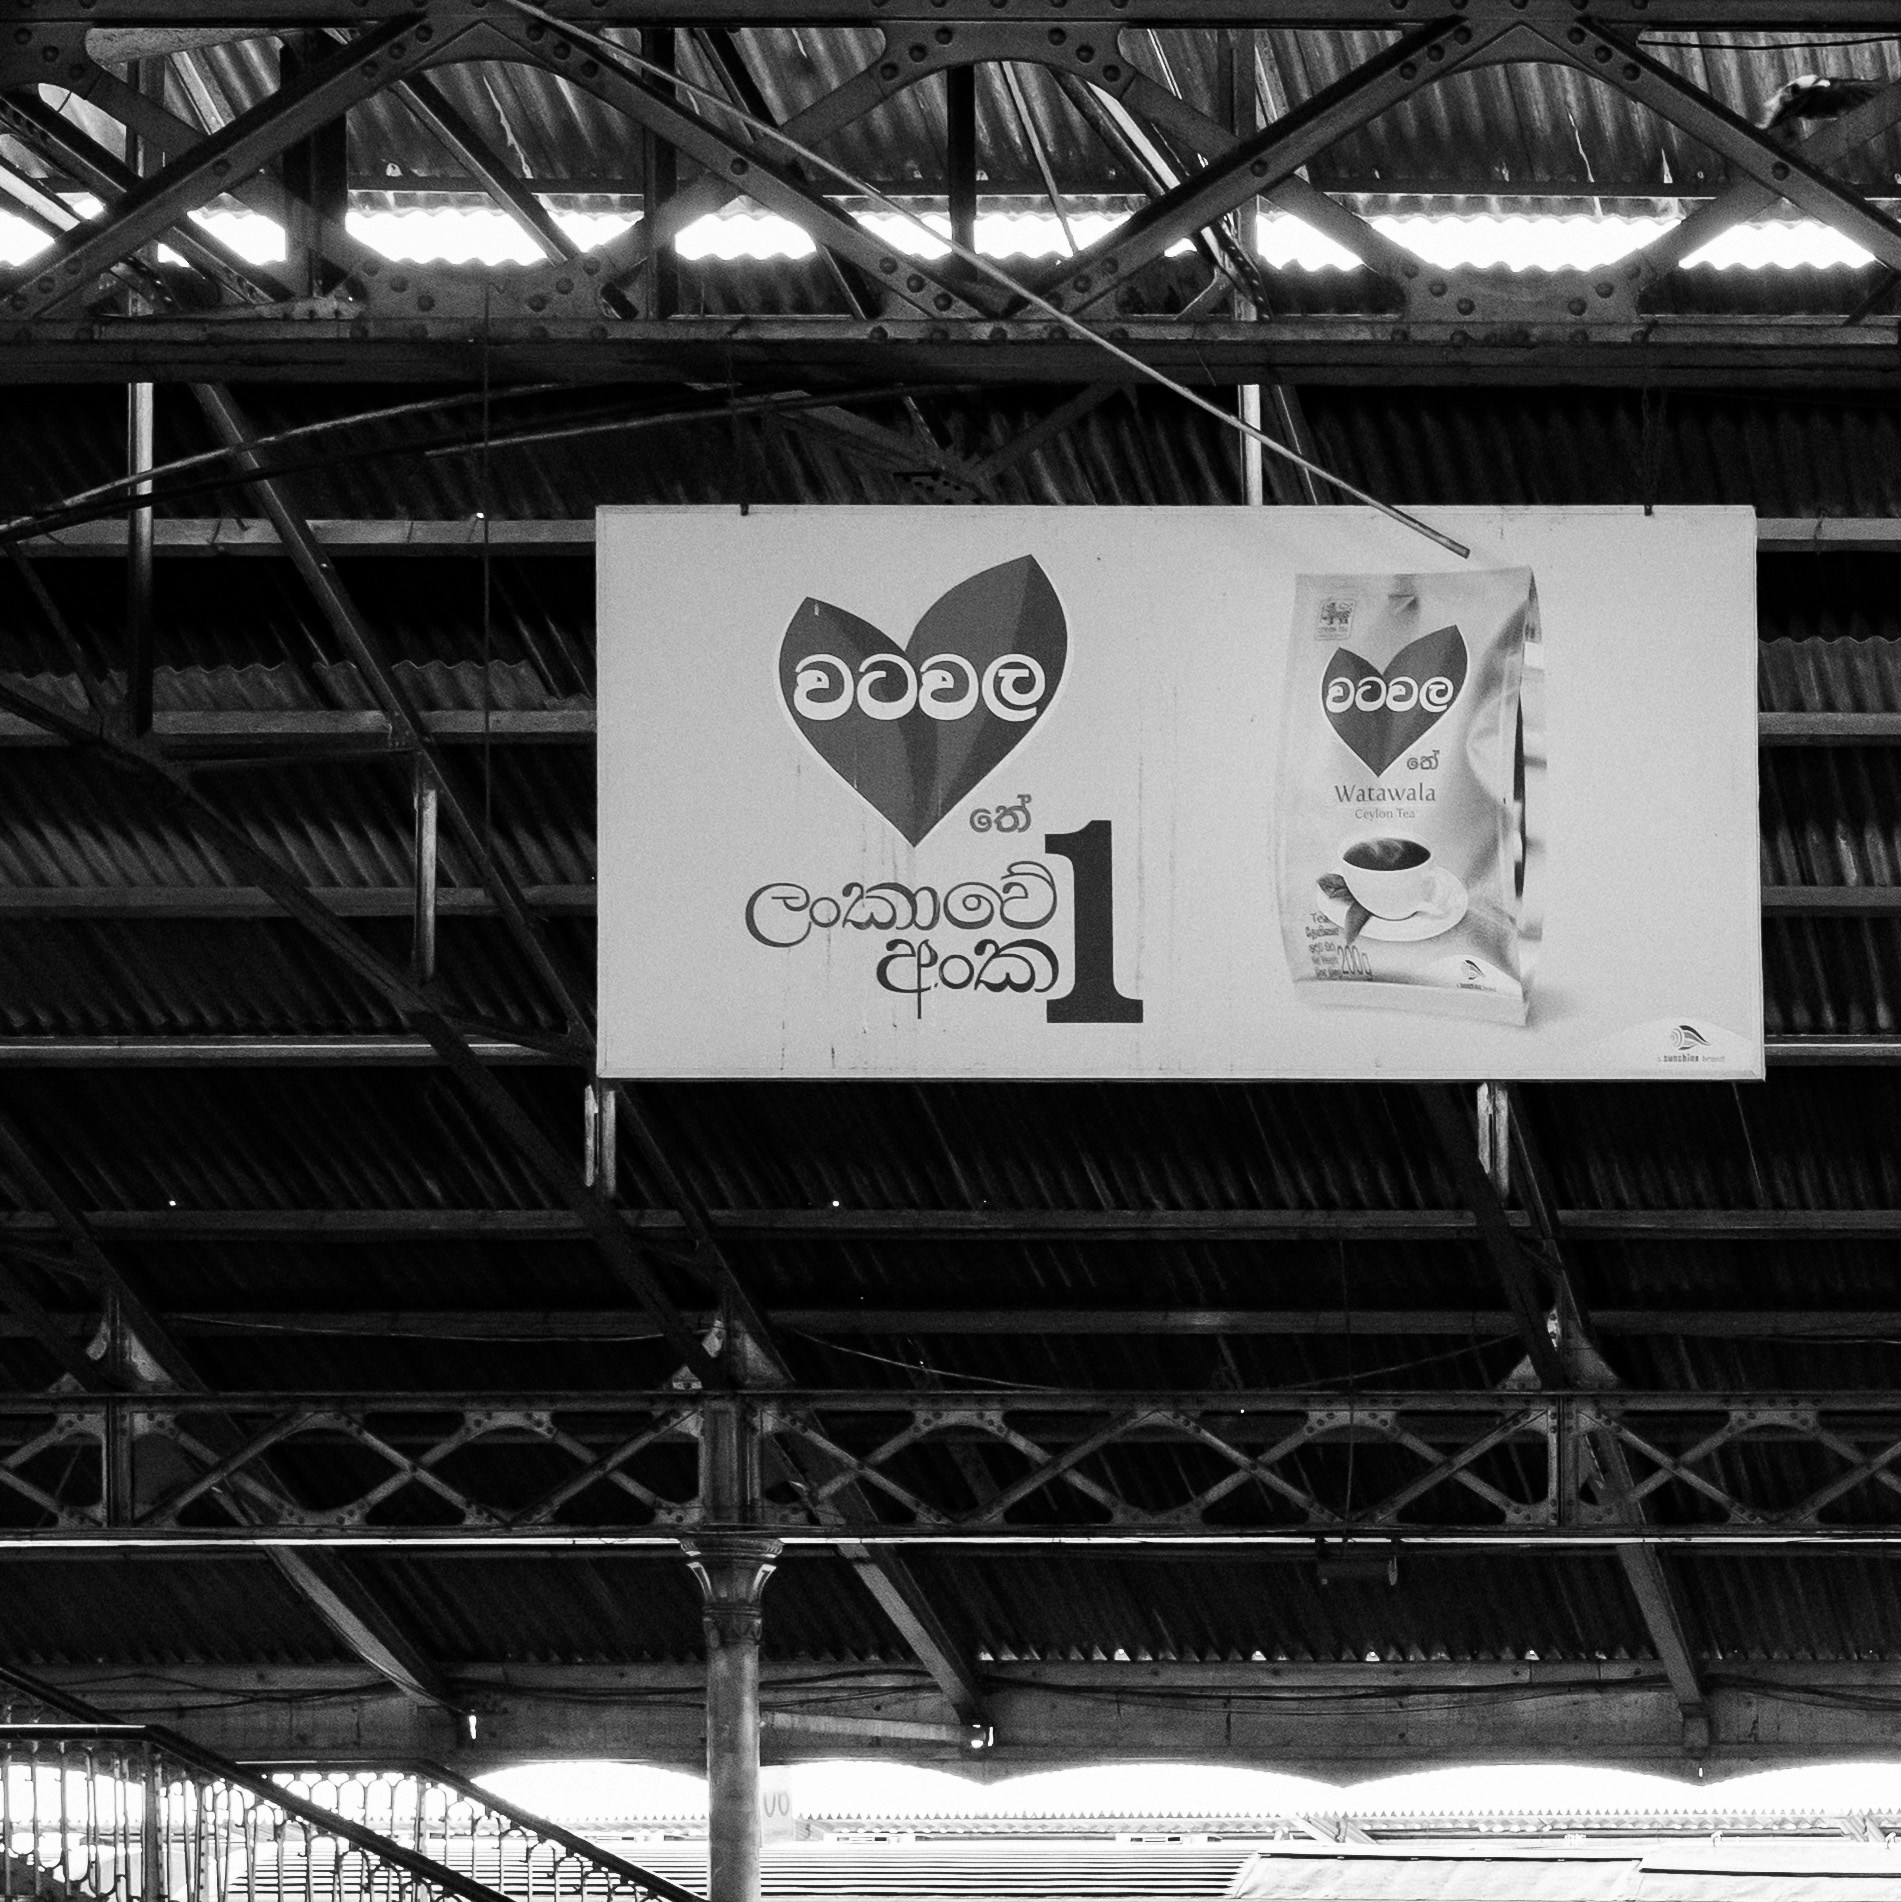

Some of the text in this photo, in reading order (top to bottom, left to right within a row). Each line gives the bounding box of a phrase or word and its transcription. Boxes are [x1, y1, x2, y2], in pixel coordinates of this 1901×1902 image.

[793, 652, 1046, 722] වටවල
[1326, 676, 1453, 713] වටවල
[1334, 782, 1436, 803] Watawala
[1354, 808, 1415, 822] Ceylon Tea
[745, 861, 1057, 948] ලංකාවේ
[876, 820, 1143, 1023] අංක 1
